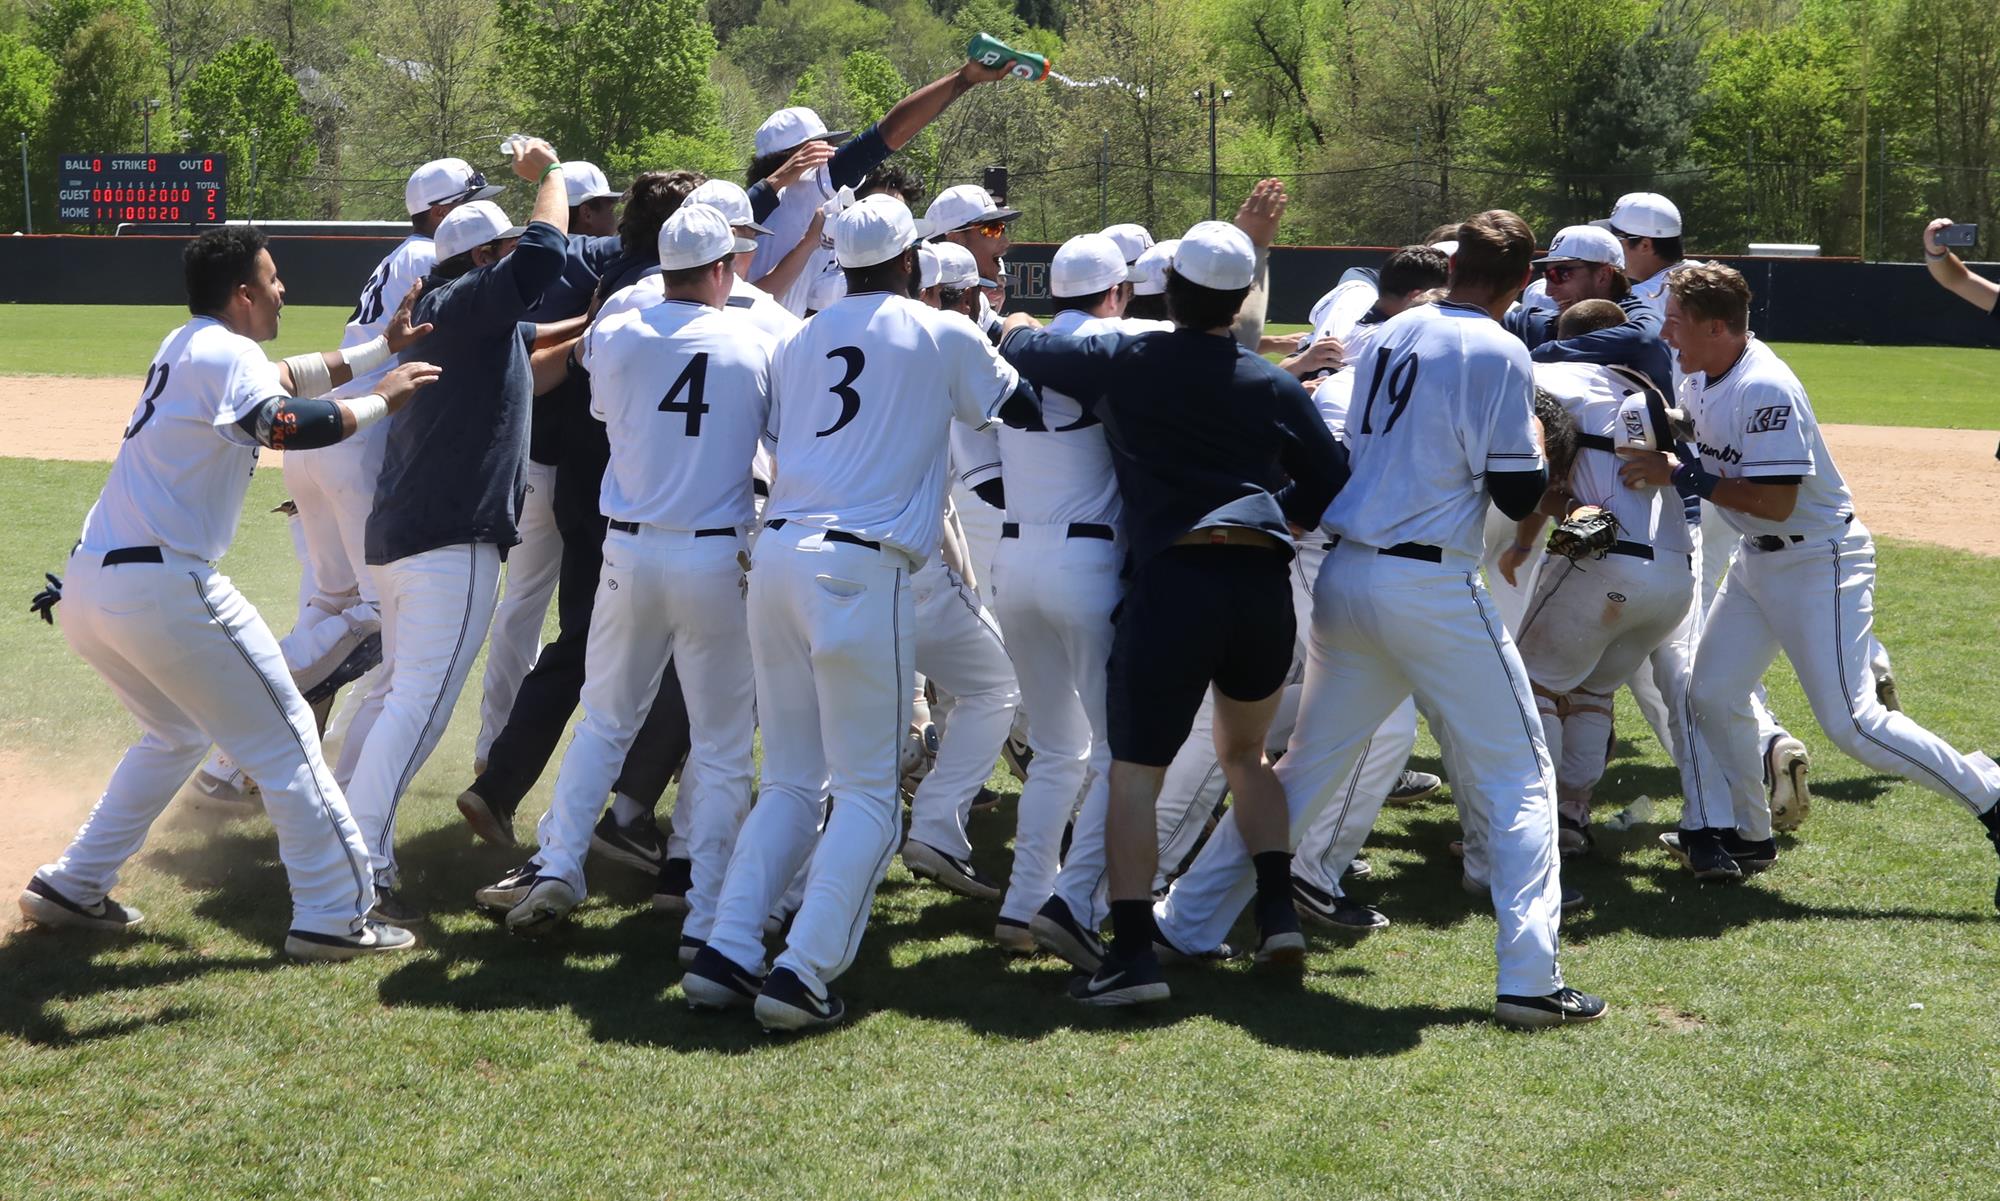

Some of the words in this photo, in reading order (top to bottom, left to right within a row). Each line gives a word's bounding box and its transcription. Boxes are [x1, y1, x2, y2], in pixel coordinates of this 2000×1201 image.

[65, 160, 91, 170] BALL
[112, 160, 147, 170] STRIKE
[179, 160, 203, 170] OUT
[60, 190, 91, 200] GUEST
[208, 189, 215, 202] 2
[196, 182, 221, 190] TOTAL
[62, 207, 90, 218] HOME
[208, 206, 215, 220] 5
[658, 352, 710, 437] 4
[815, 345, 866, 438] 3
[1360, 346, 1419, 437] 19
[1745, 405, 1792, 434] KC
